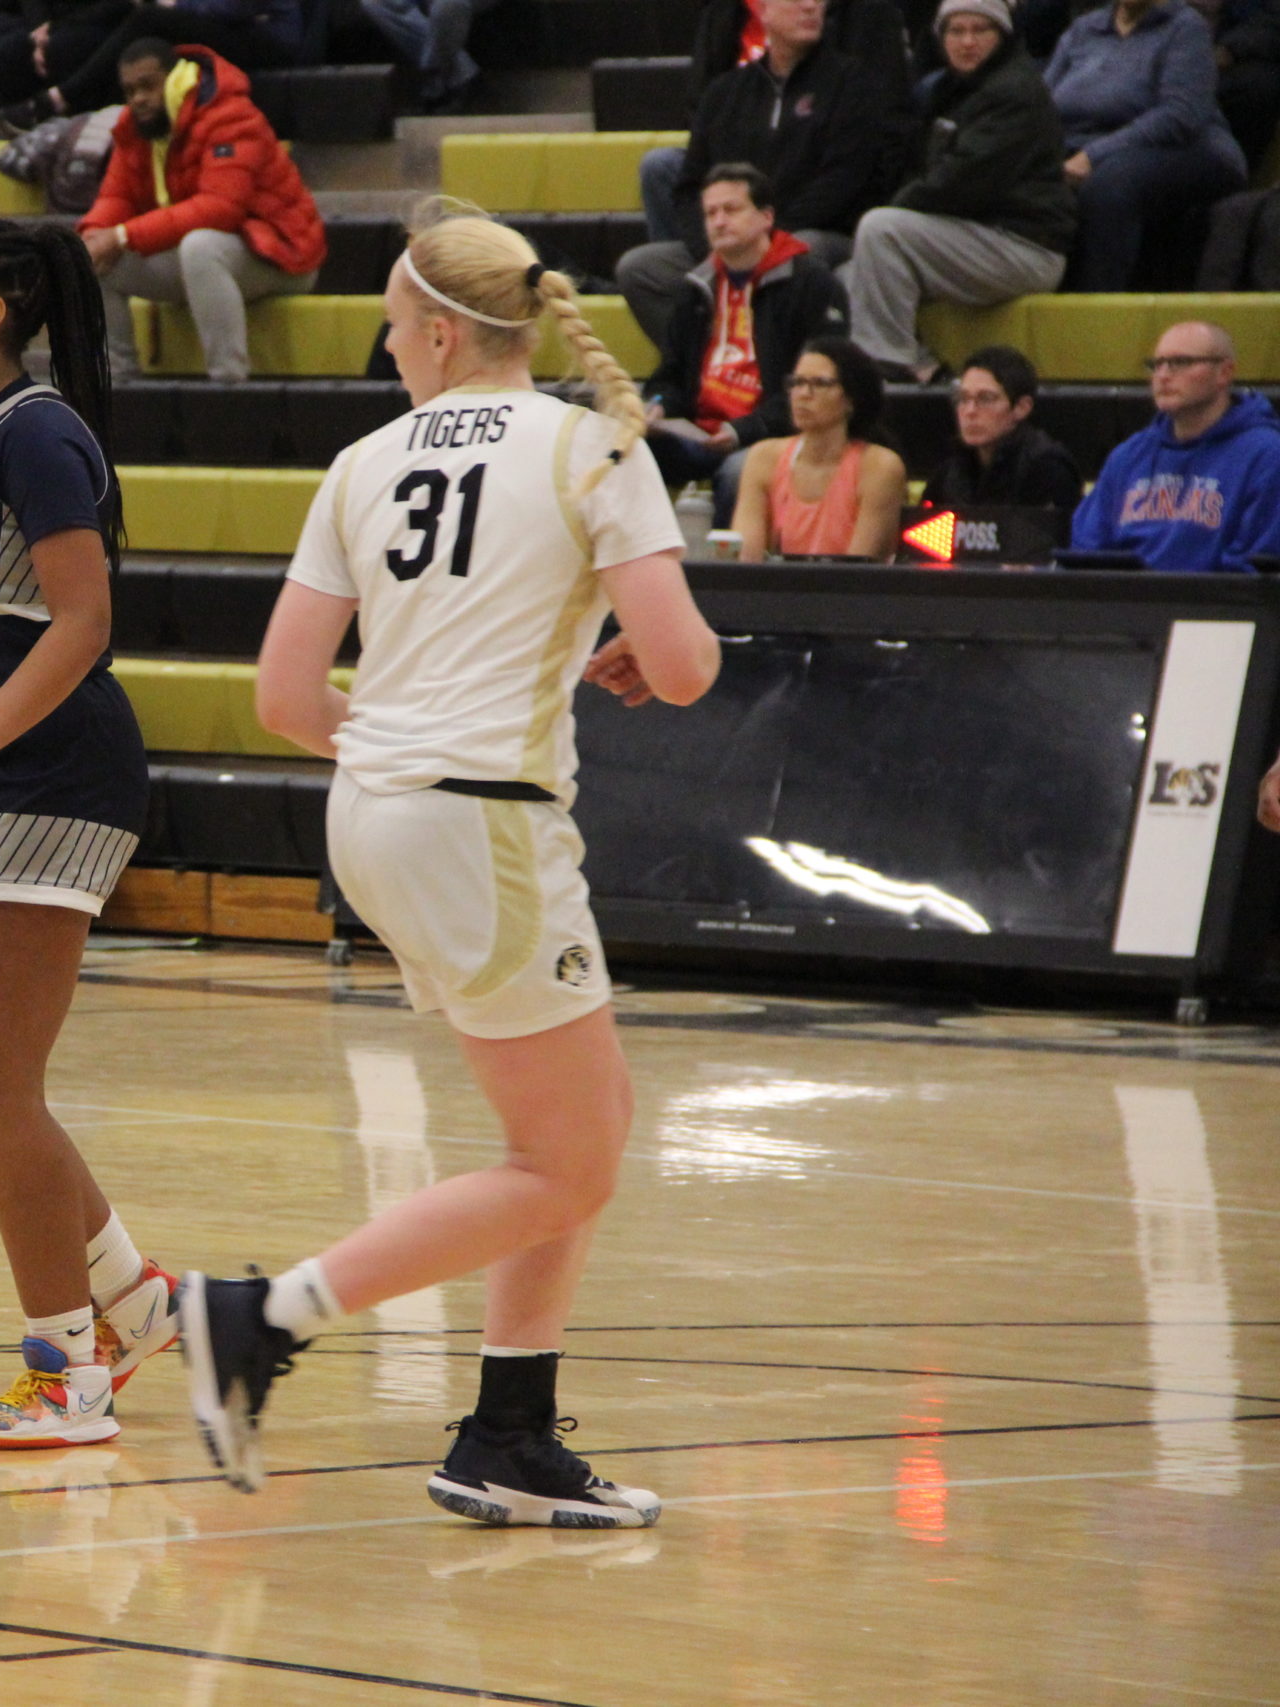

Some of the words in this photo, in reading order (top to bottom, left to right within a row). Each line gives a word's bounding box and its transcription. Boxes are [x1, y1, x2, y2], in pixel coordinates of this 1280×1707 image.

[407, 405, 513, 451] TIGERS
[387, 463, 487, 581] 31
[954, 520, 1000, 550] POSS.
